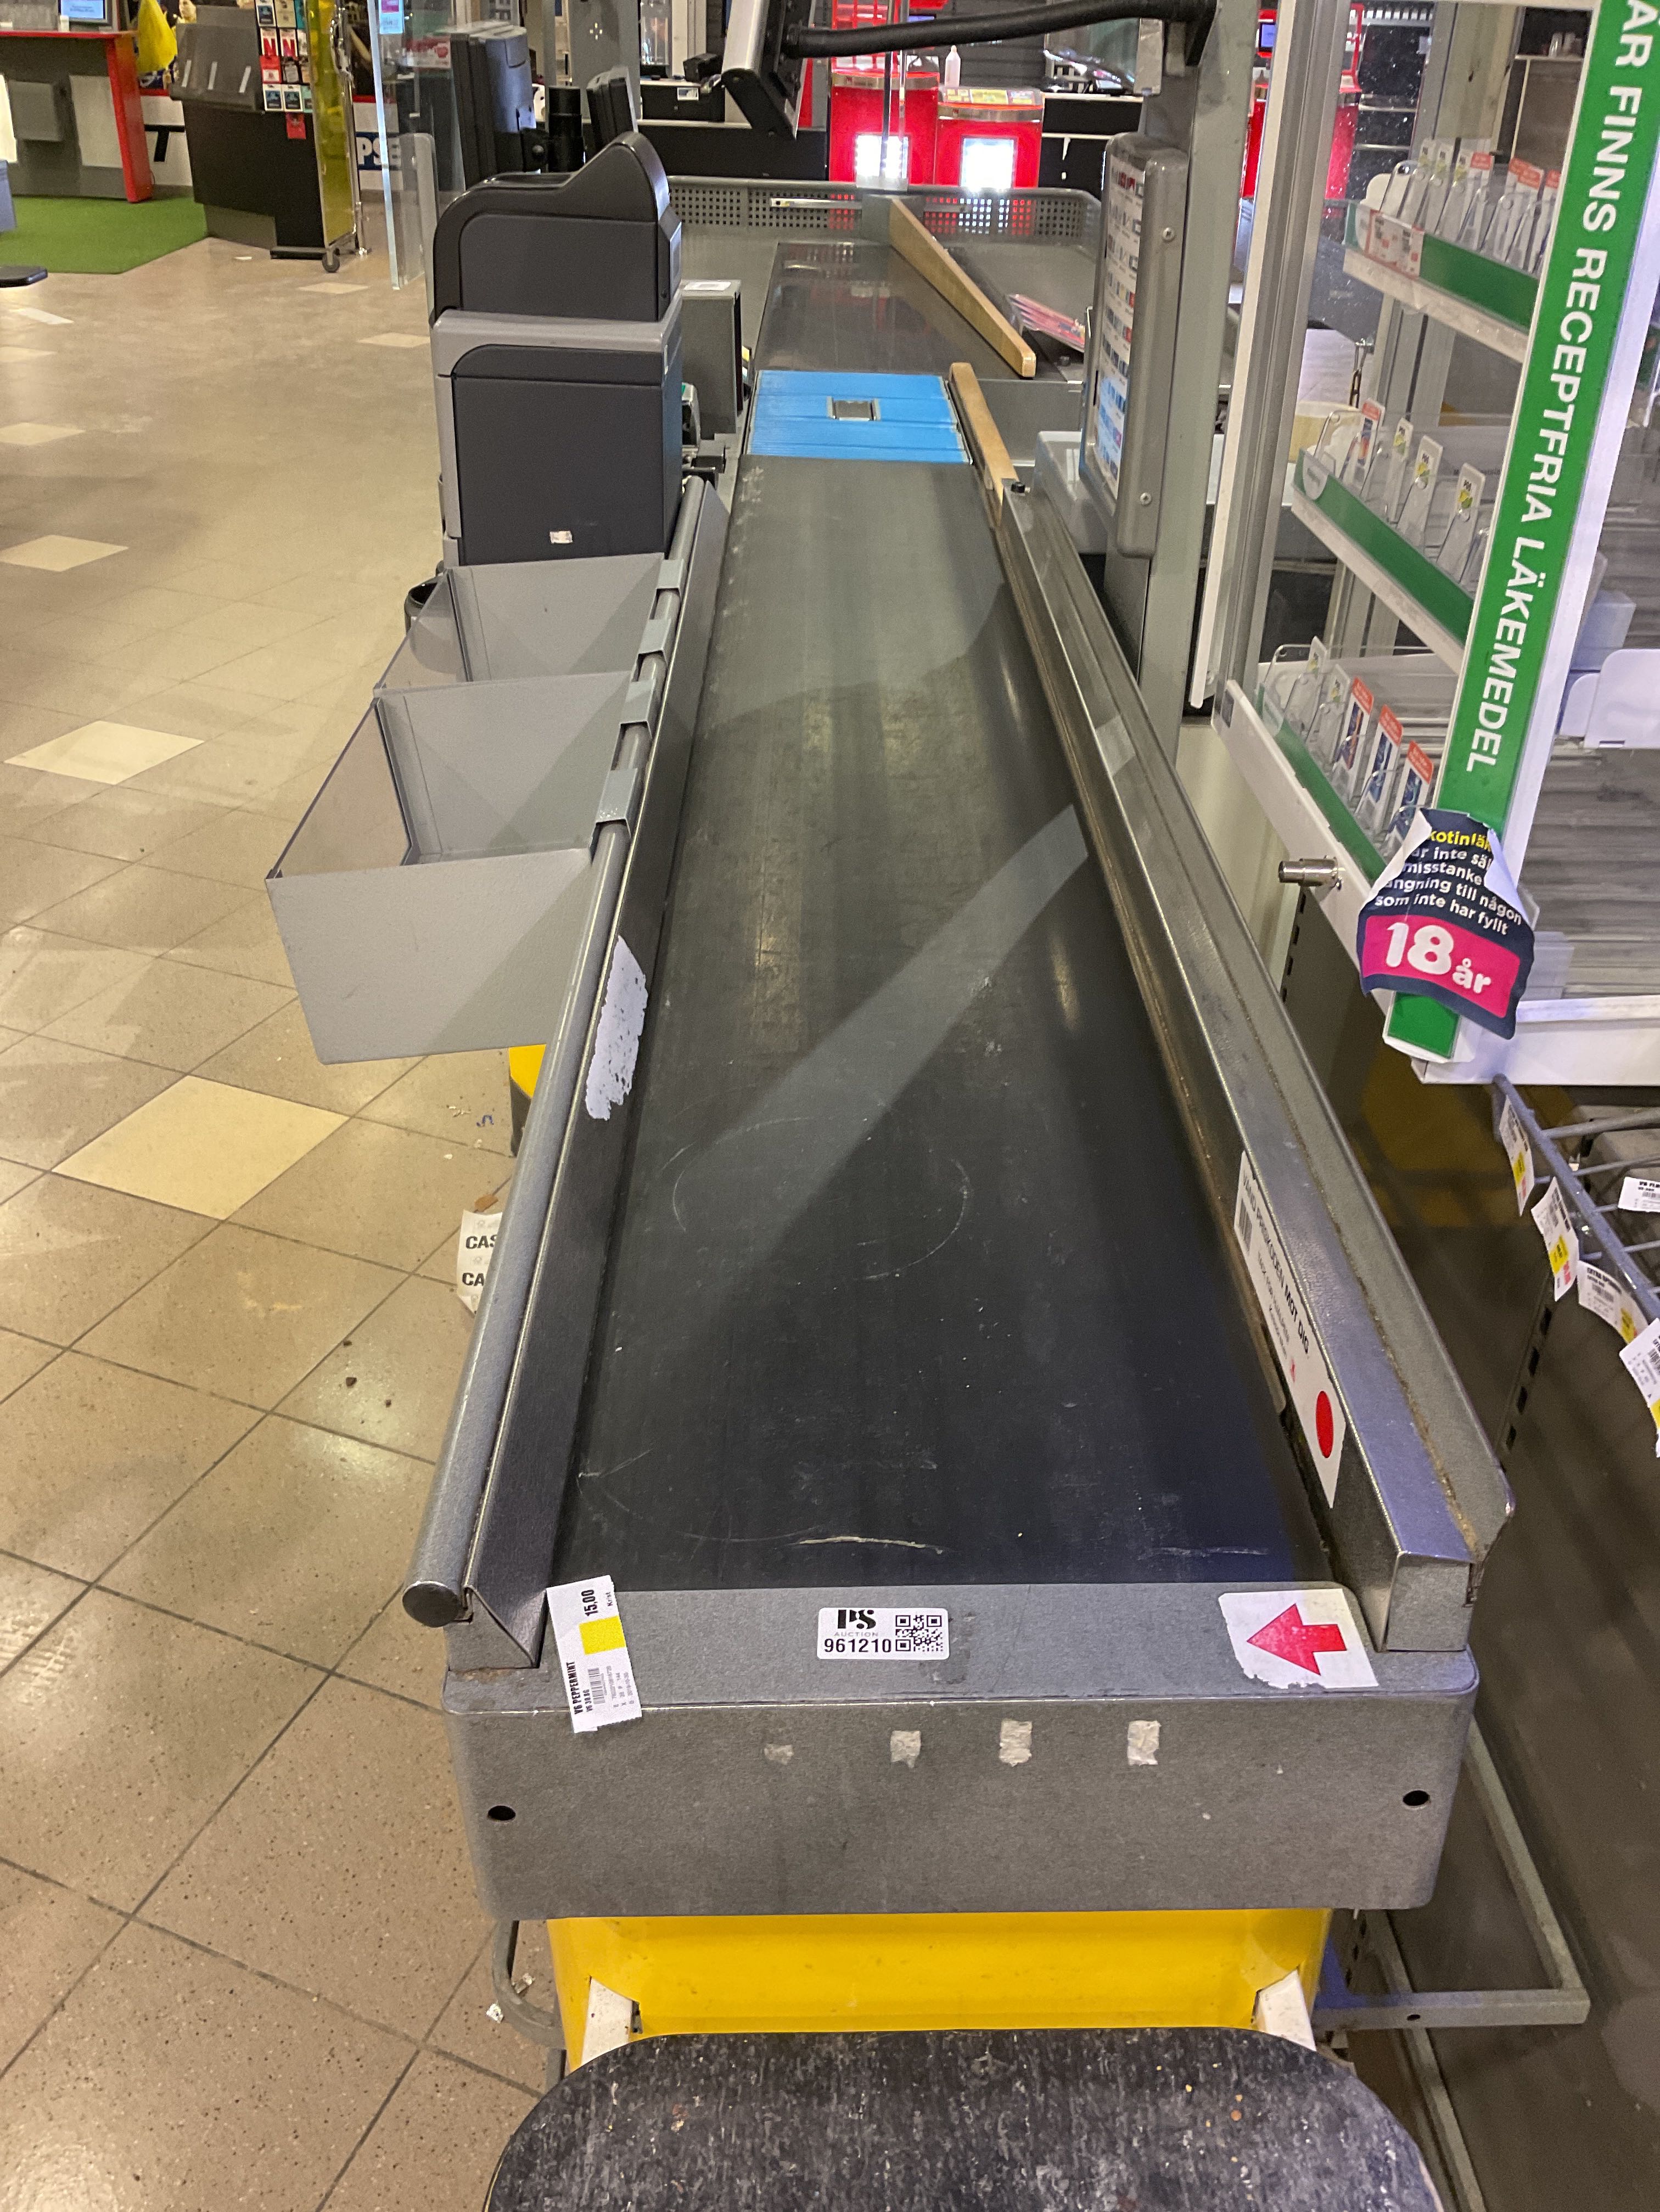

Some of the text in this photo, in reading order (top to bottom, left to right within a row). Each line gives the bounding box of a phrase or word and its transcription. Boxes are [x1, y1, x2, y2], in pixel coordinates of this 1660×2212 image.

[1583, 86, 1642, 231] FINNS
[1521, 248, 1608, 522] RECEPTFRIA
[1466, 537, 1545, 772] LÄKEMEDEL
[1402, 861, 1482, 885] misstanke
[1434, 847, 1467, 860] inte
[1375, 893, 1508, 935] som inte har fyllt
[1456, 883, 1477, 901] till
[1479, 892, 1522, 925] någon
[1386, 922, 1491, 993] 18 år
[1285, 1283, 1298, 1322] MOT
[1298, 1318, 1309, 1354] DIG
[581, 1590, 598, 1616] 15,00
[824, 1638, 892, 1653] 961210
[566, 1661, 583, 1715] V6 PEPPERMINT
